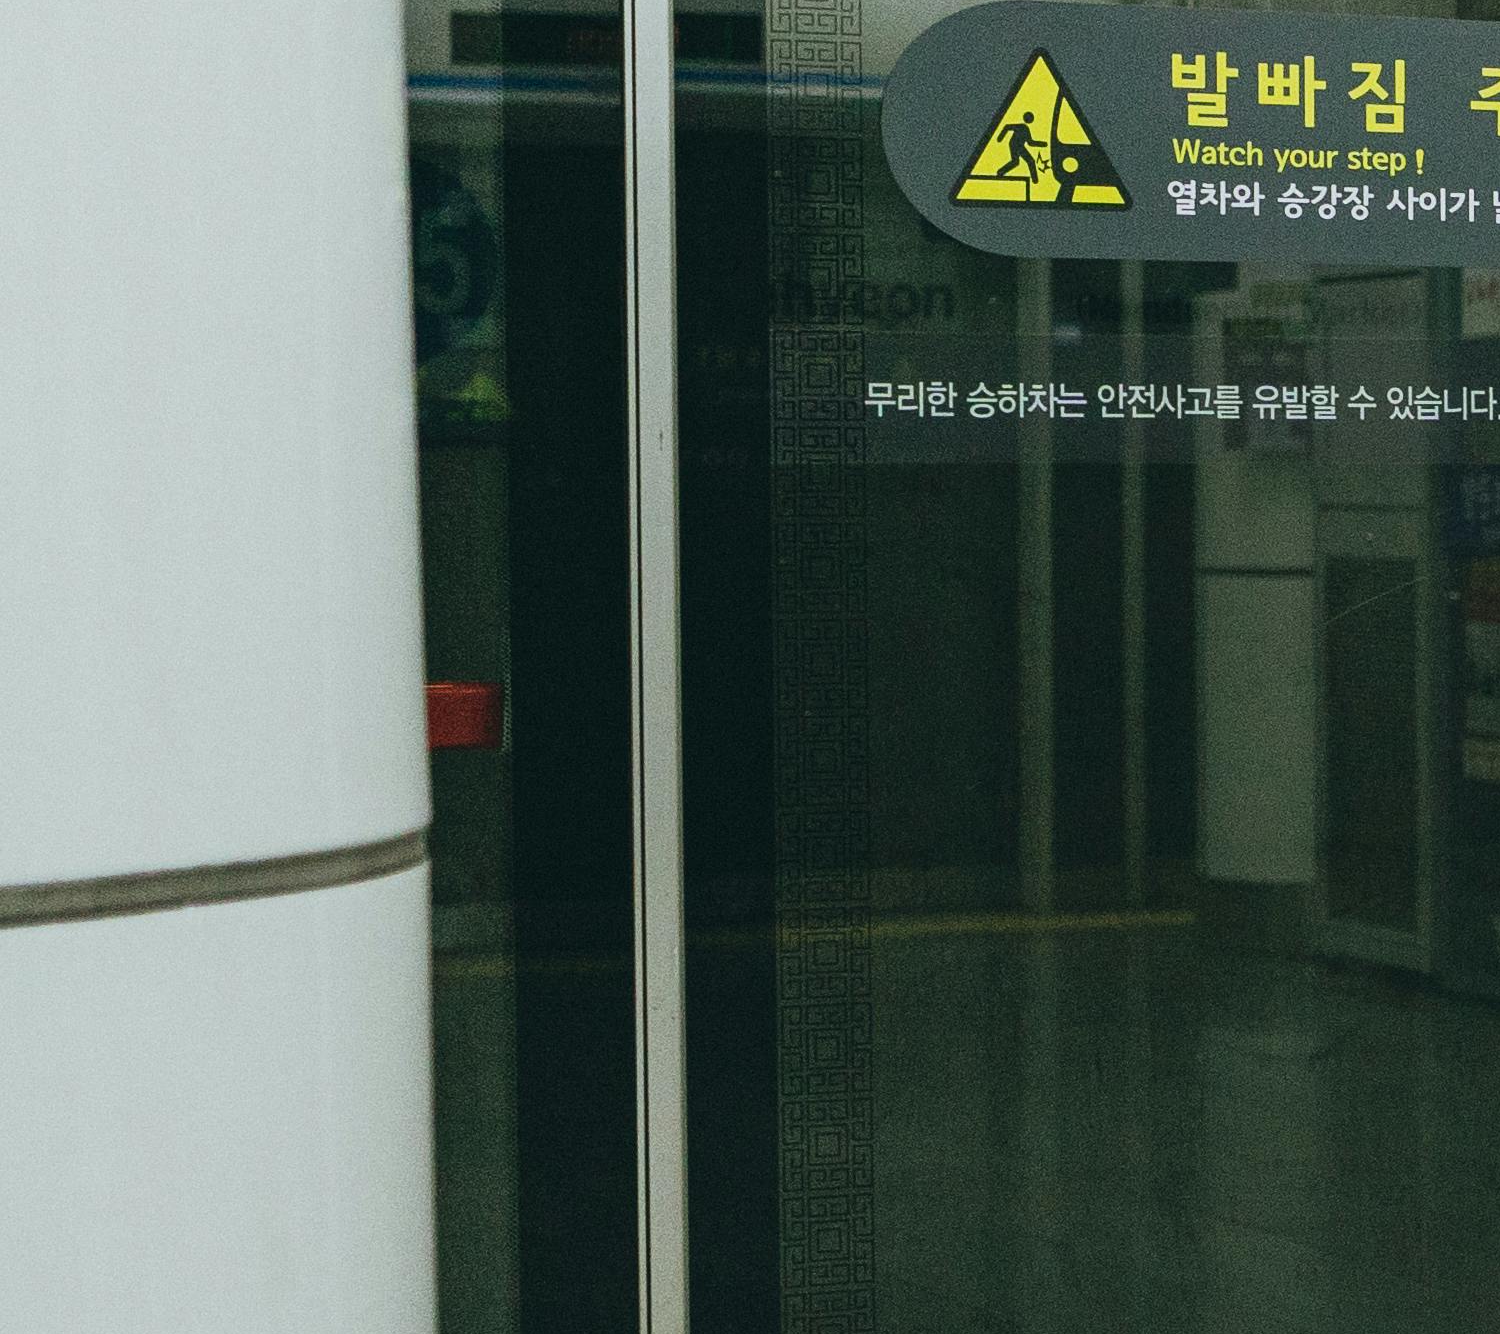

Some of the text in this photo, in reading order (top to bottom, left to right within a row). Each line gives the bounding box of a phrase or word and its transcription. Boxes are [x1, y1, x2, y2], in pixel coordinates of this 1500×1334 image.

[1172, 138, 1263, 169] Watch
[1275, 145, 1338, 175] your
[1167, 180, 1263, 216] 열차와
[1278, 182, 1374, 221] 승강장
[1387, 187, 1480, 225] 사이가
[865, 383, 958, 418] 무리한
[969, 383, 1088, 420] 승하차는
[1097, 385, 1243, 420] 안전사고를
[1253, 386, 1340, 421] 유발할
[1349, 388, 1379, 421] 수
